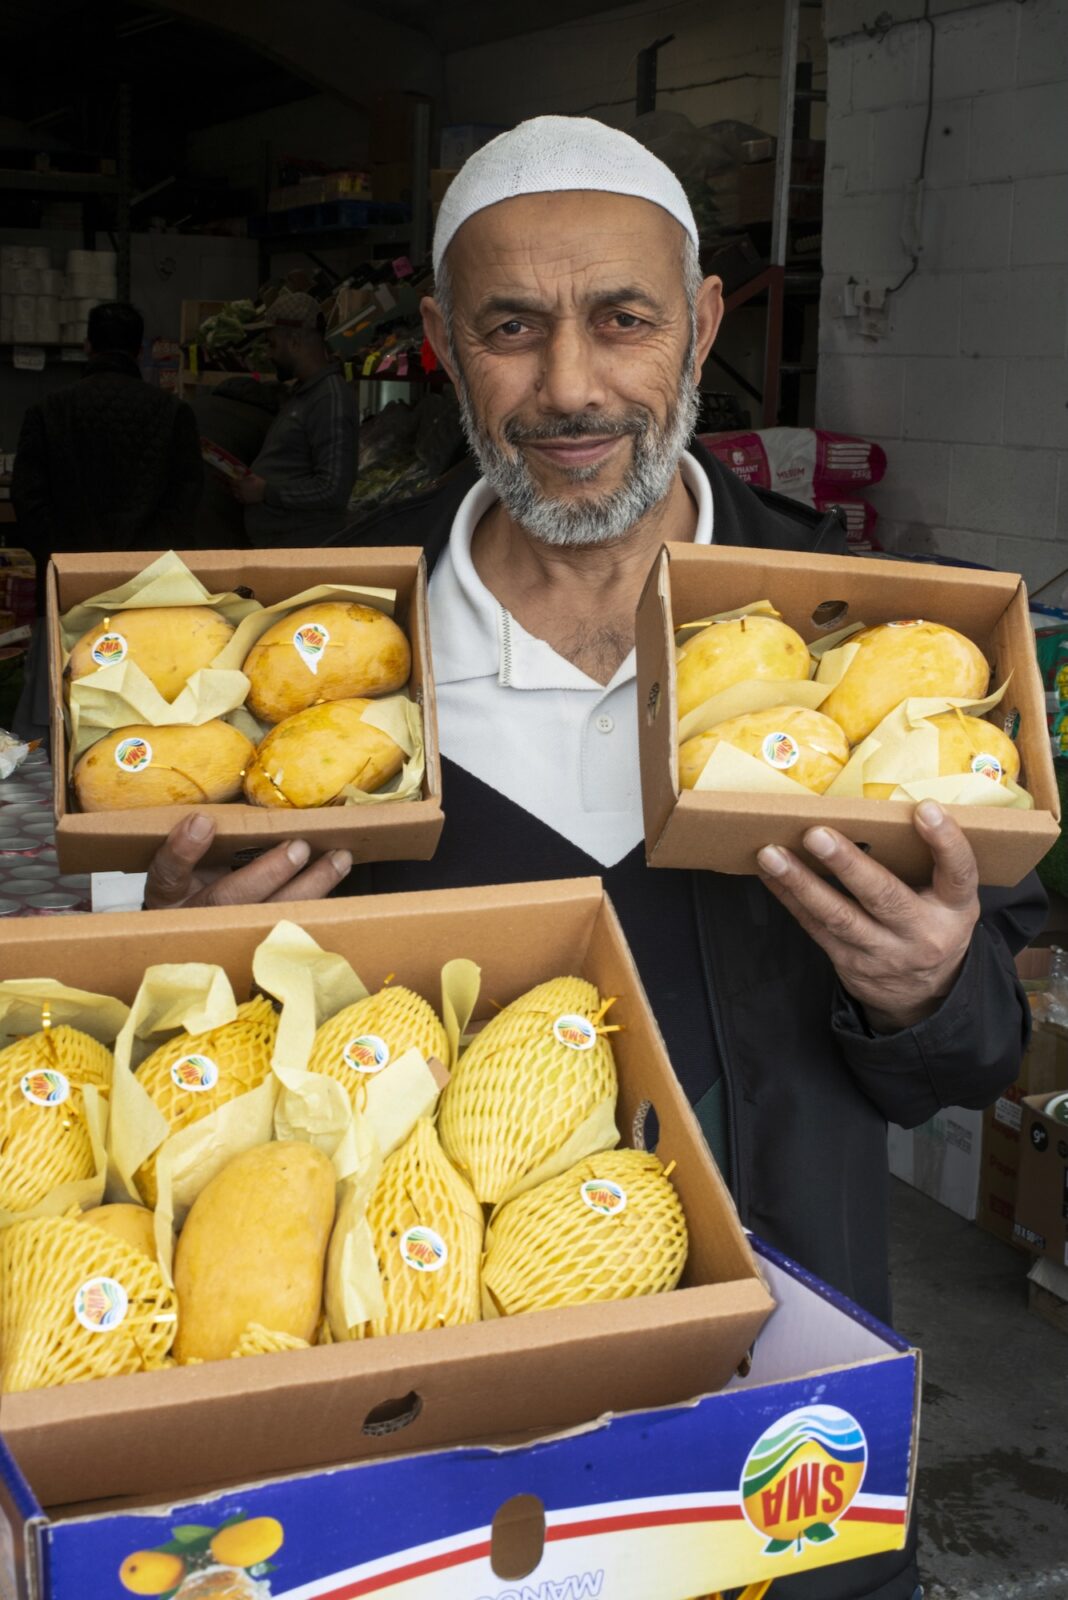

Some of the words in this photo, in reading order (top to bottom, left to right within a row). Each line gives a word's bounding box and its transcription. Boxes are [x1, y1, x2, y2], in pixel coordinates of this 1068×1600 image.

[98, 641, 122, 654] SMA
[302, 628, 323, 646] SMA
[126, 747, 147, 766] SMA
[775, 741, 794, 763] SMA
[560, 1028, 586, 1045] SMA
[349, 1045, 376, 1066] SMA
[180, 1063, 202, 1084] SMA
[32, 1074, 50, 1100] SMA
[589, 1190, 615, 1208] SMA
[406, 1241, 434, 1265] SMA
[85, 1287, 106, 1320] SMA
[761, 1463, 844, 1527] SMA
